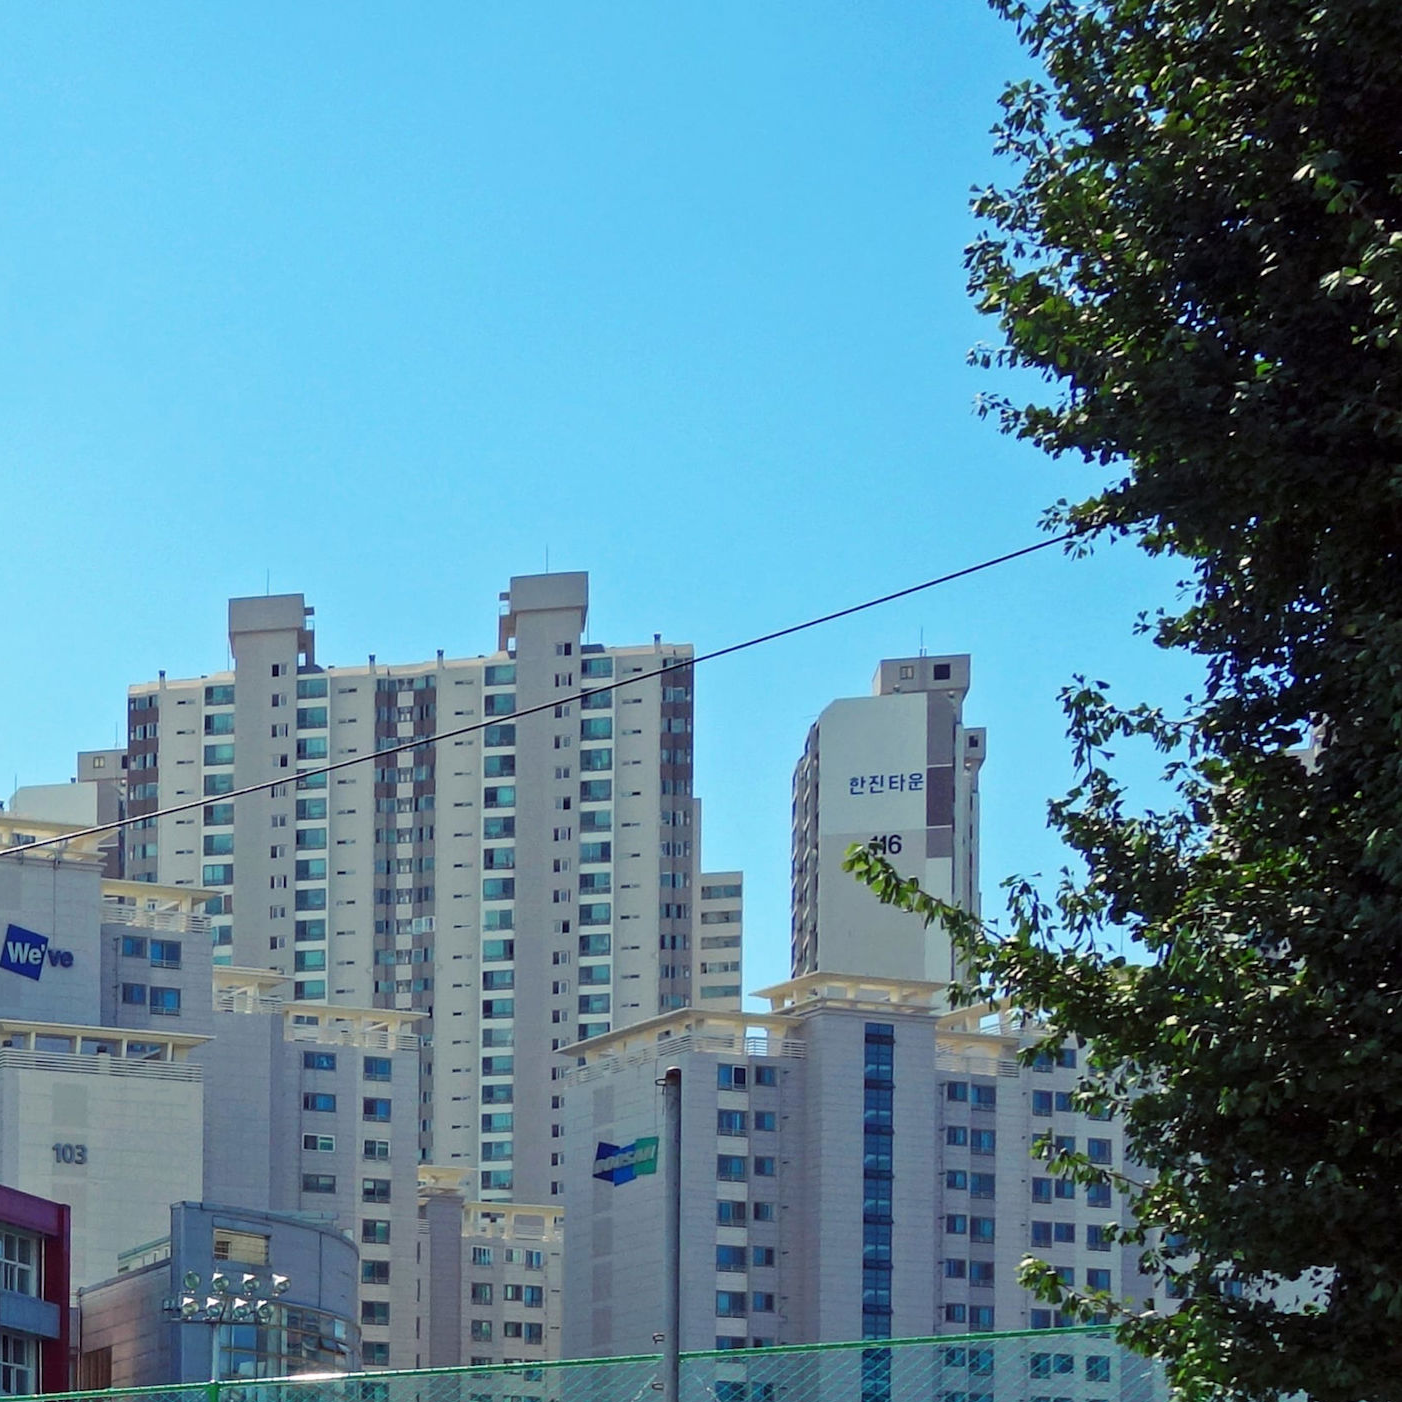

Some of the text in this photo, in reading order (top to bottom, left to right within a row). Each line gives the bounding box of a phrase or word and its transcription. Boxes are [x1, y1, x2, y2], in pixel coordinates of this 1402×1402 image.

[849, 772, 924, 796] 한진타운
[869, 834, 902, 855] 116
[7, 940, 74, 968] We've
[52, 1143, 88, 1165] 103
